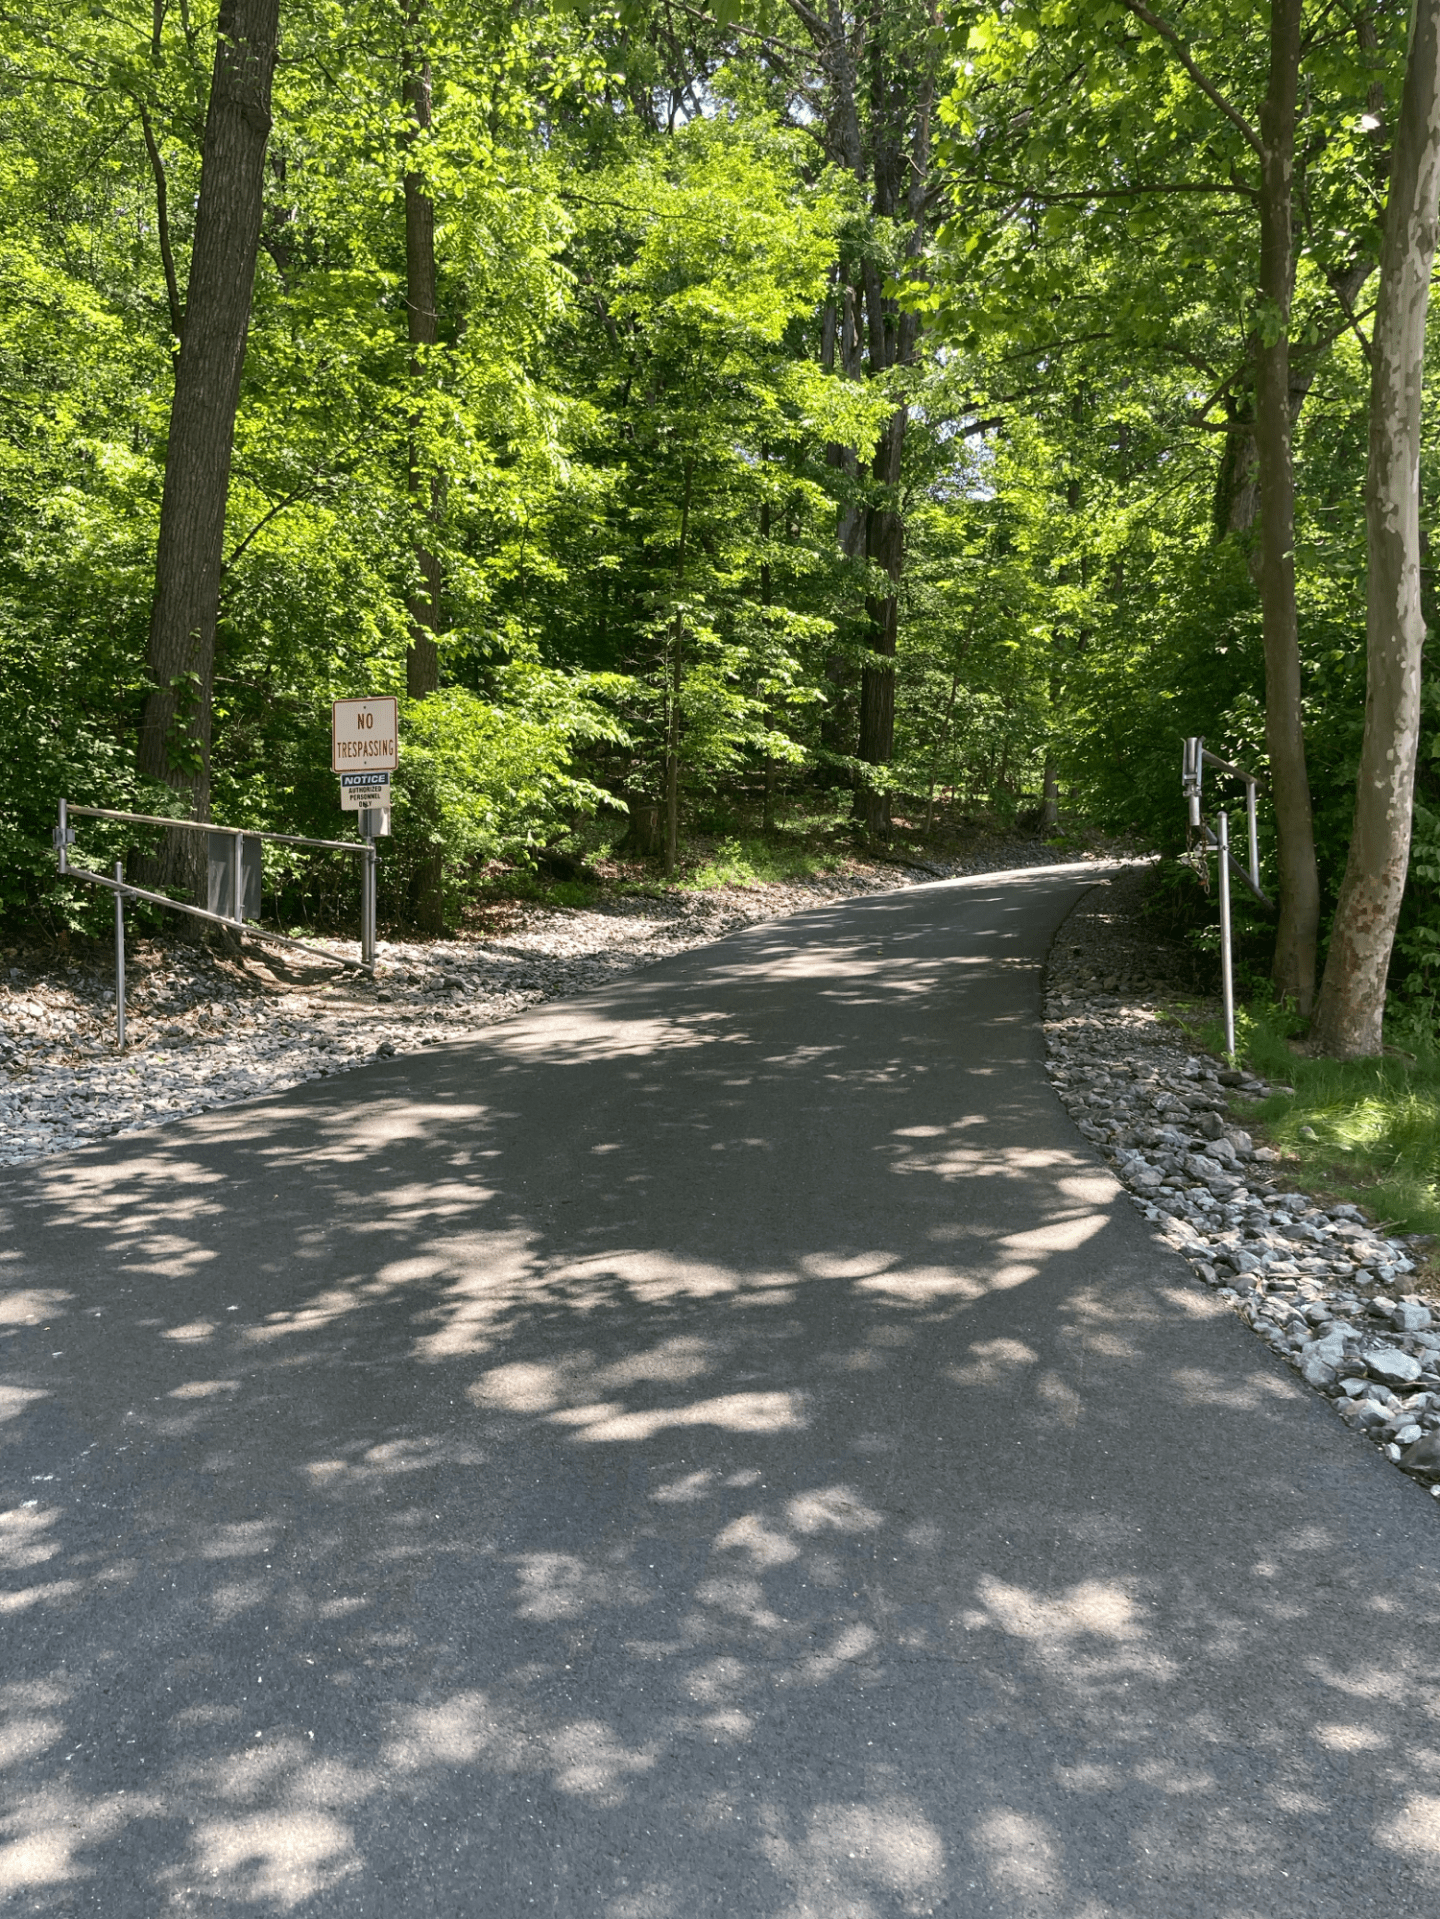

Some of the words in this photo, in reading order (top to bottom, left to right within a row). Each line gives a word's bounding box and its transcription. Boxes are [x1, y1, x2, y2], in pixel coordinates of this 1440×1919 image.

[357, 712, 374, 730] NO
[337, 739, 394, 758] TRESPASSING
[344, 774, 386, 785] NOTICE
[348, 785, 382, 793] AUTHORIZED
[349, 793, 381, 801] PERSONNEL
